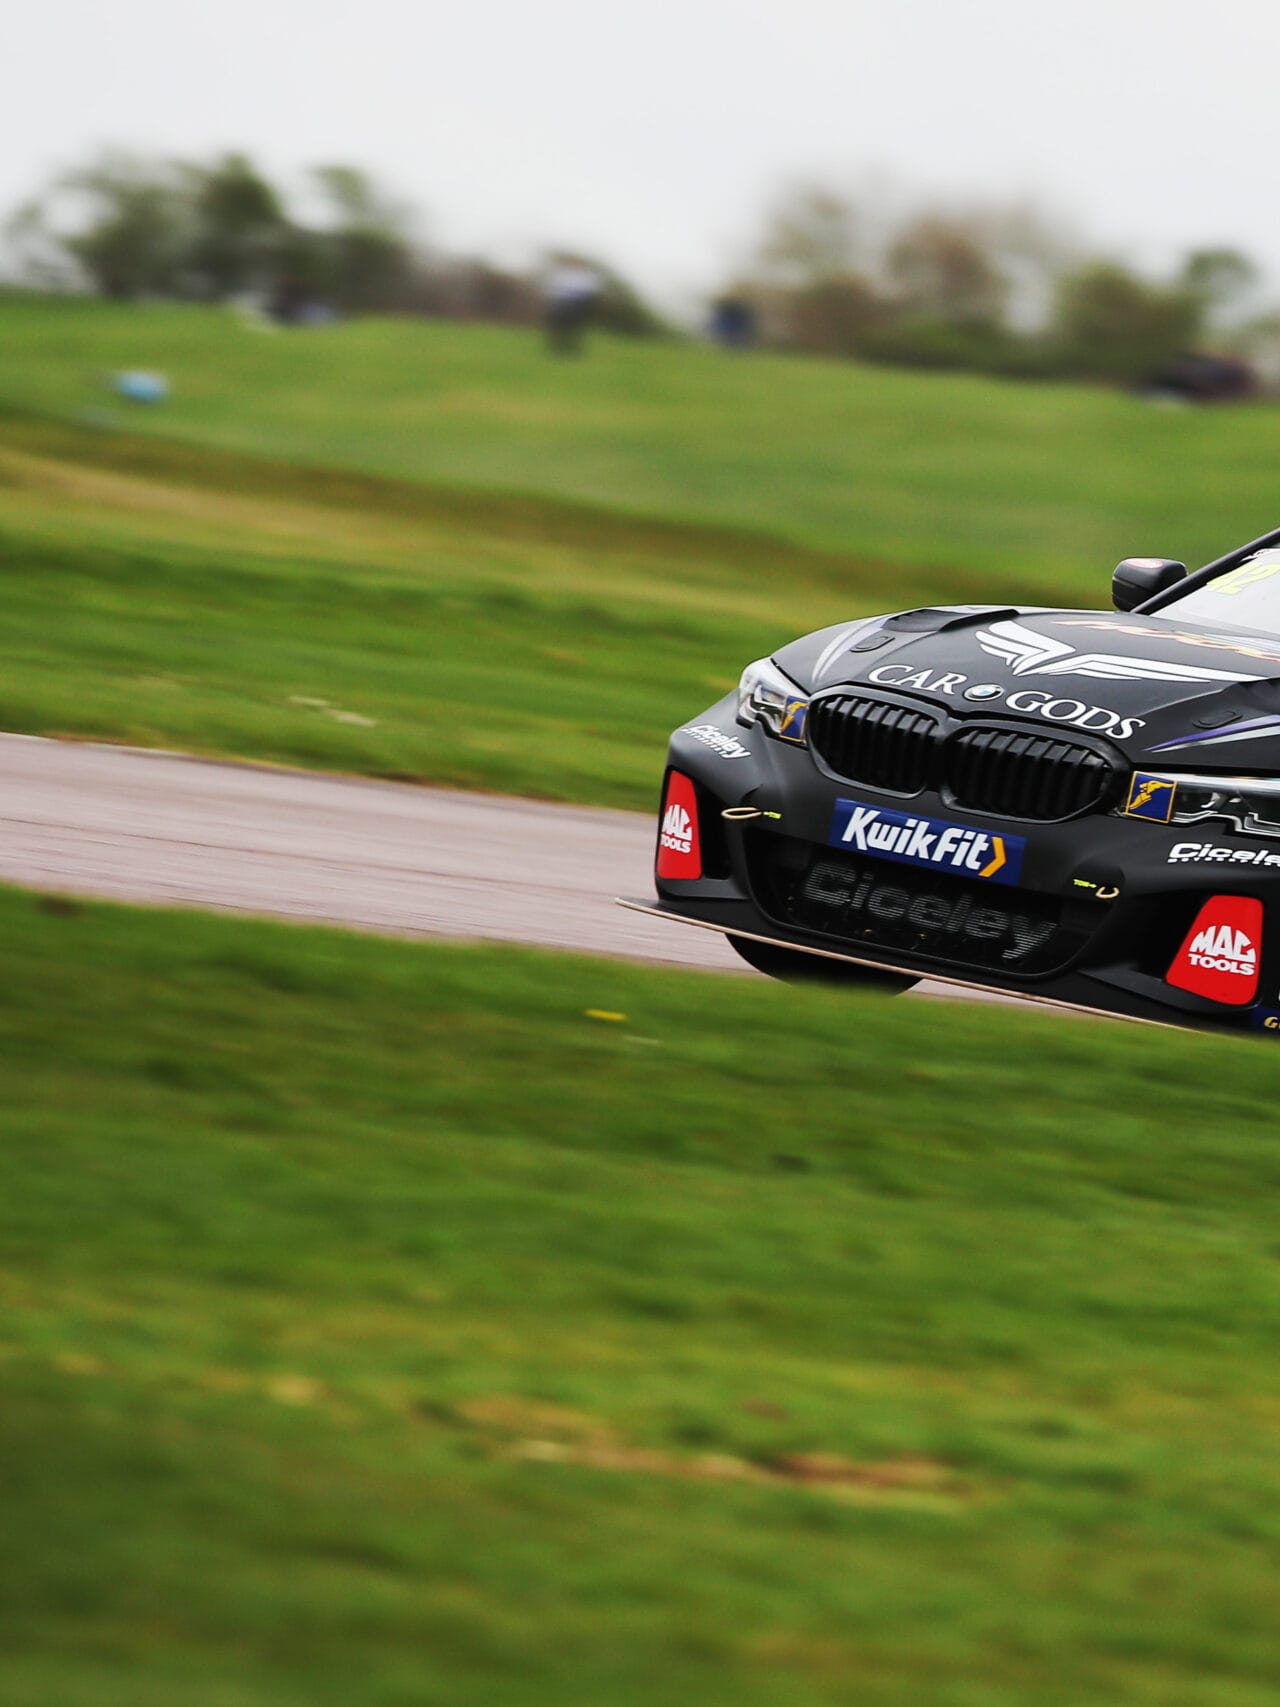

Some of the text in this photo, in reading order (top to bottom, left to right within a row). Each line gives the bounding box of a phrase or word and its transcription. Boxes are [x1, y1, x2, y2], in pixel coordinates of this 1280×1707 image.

[867, 664, 1147, 741] CAR GODS
[690, 724, 752, 759] Ciceley
[662, 804, 693, 841] MAC
[803, 862, 1057, 959] Ciceley
[1189, 925, 1256, 963] MAC
[1188, 953, 1255, 976] TOOLS
